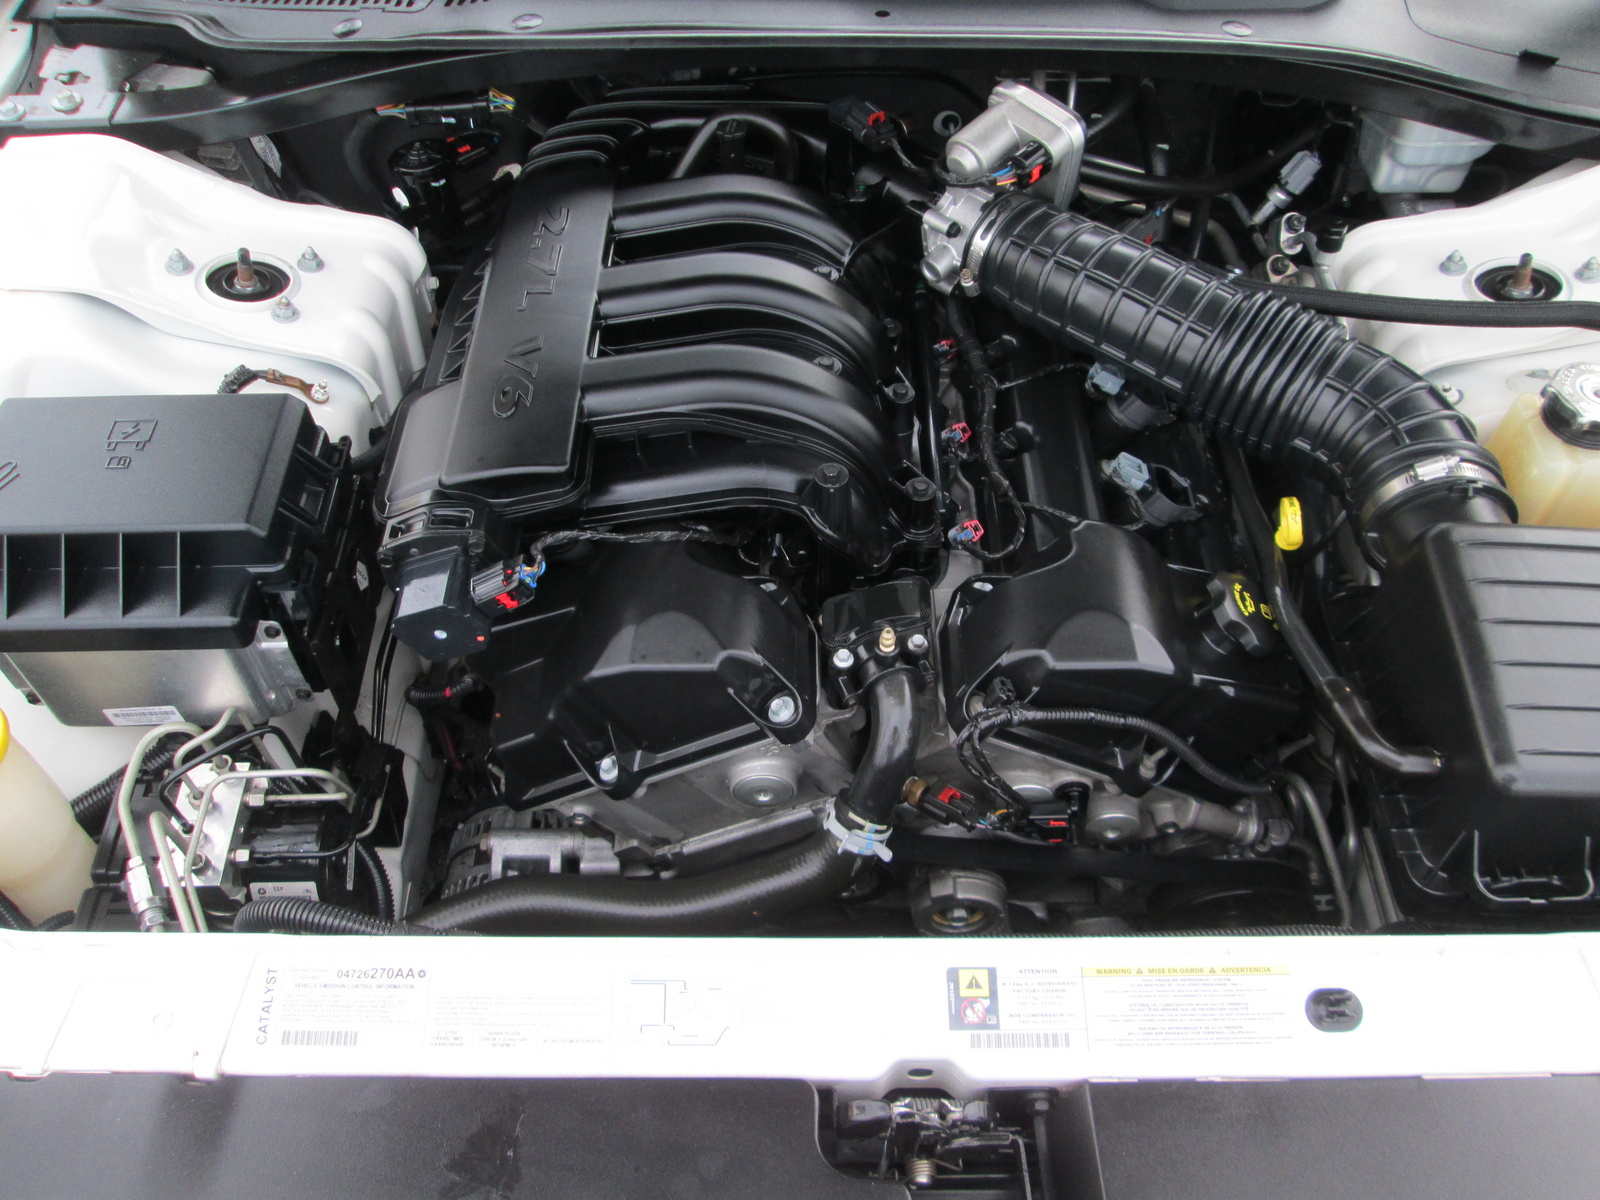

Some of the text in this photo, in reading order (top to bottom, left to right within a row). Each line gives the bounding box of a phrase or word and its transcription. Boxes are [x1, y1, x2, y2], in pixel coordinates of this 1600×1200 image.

[492, 333, 546, 418] V6
[337, 967, 415, 980] 04726270AA
[1221, 966, 1272, 974] ADVERTENCIA
[255, 967, 278, 1046] CATALYST
